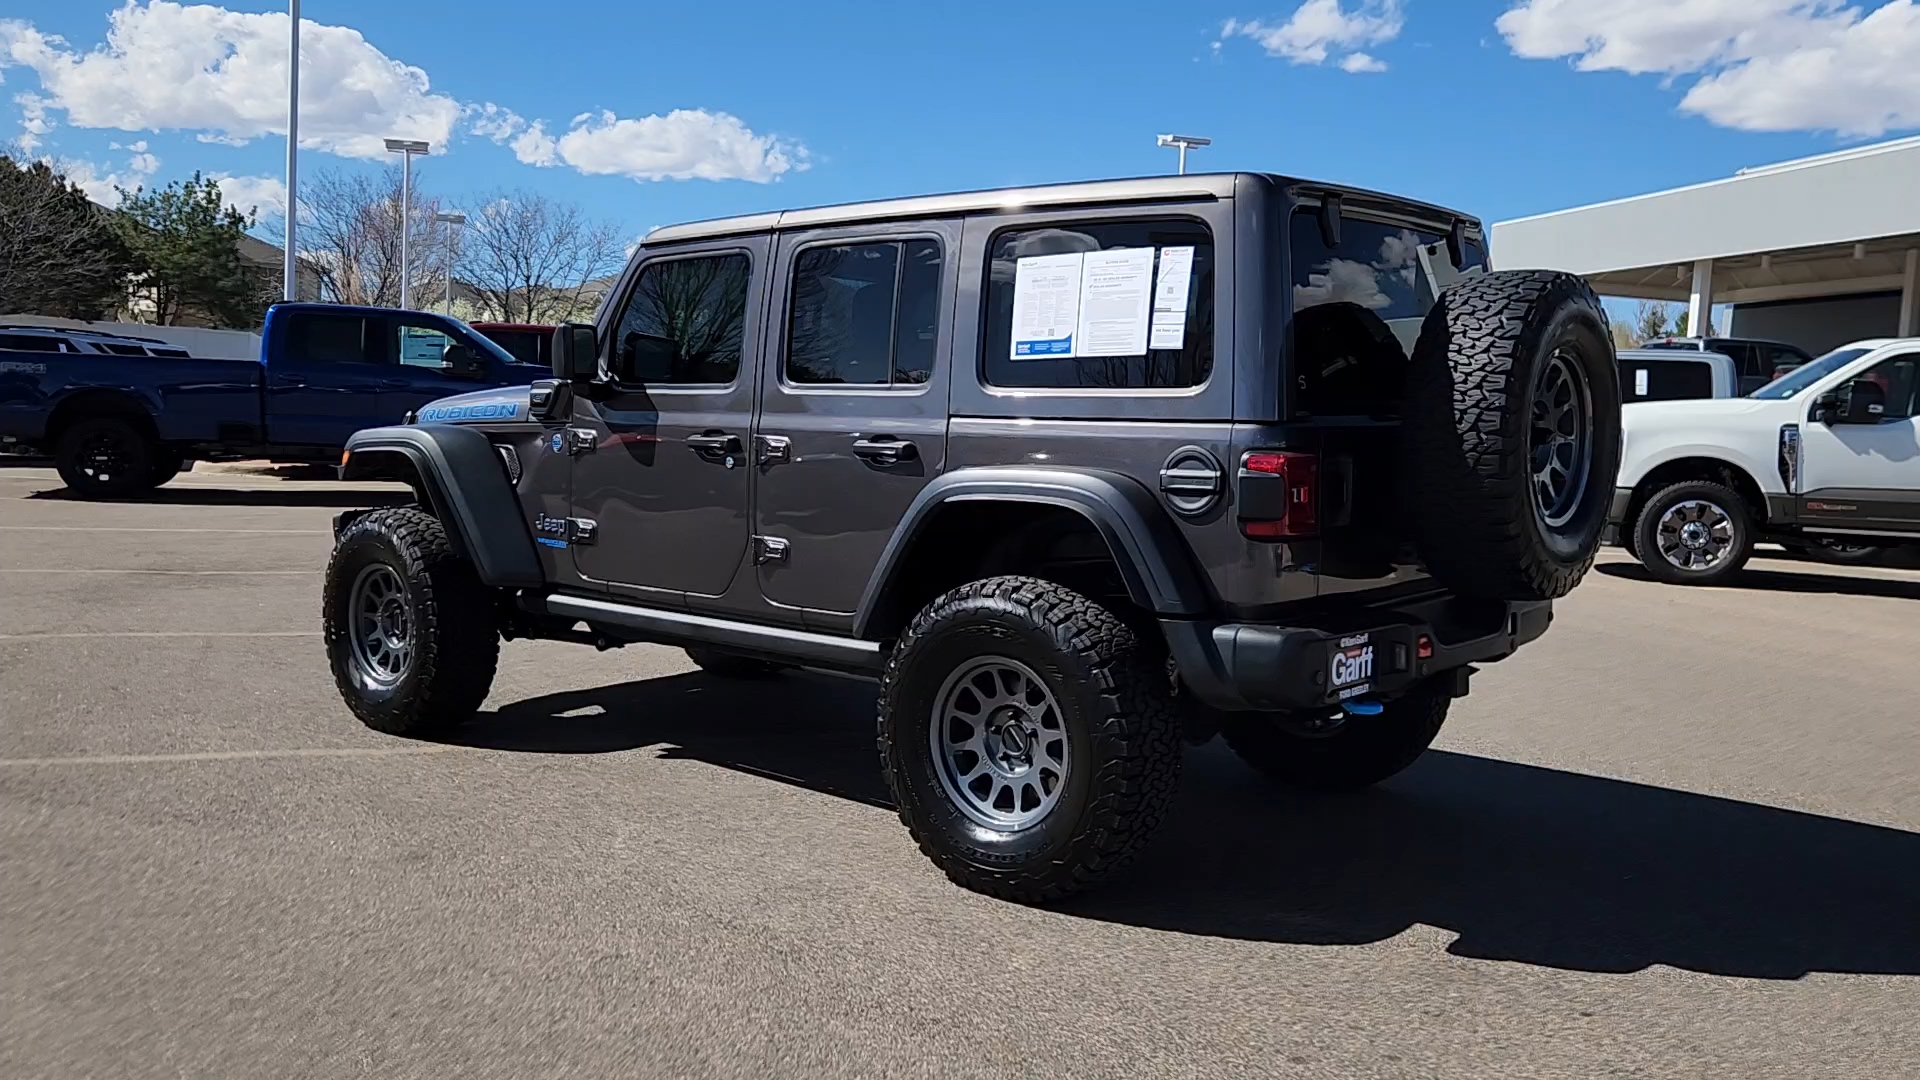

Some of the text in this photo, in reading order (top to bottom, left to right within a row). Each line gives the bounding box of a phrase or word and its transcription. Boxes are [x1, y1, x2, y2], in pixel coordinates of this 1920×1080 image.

[421, 403, 518, 421] RUBICON
[535, 512, 565, 536] Jeep
[1331, 645, 1373, 686] Garff
